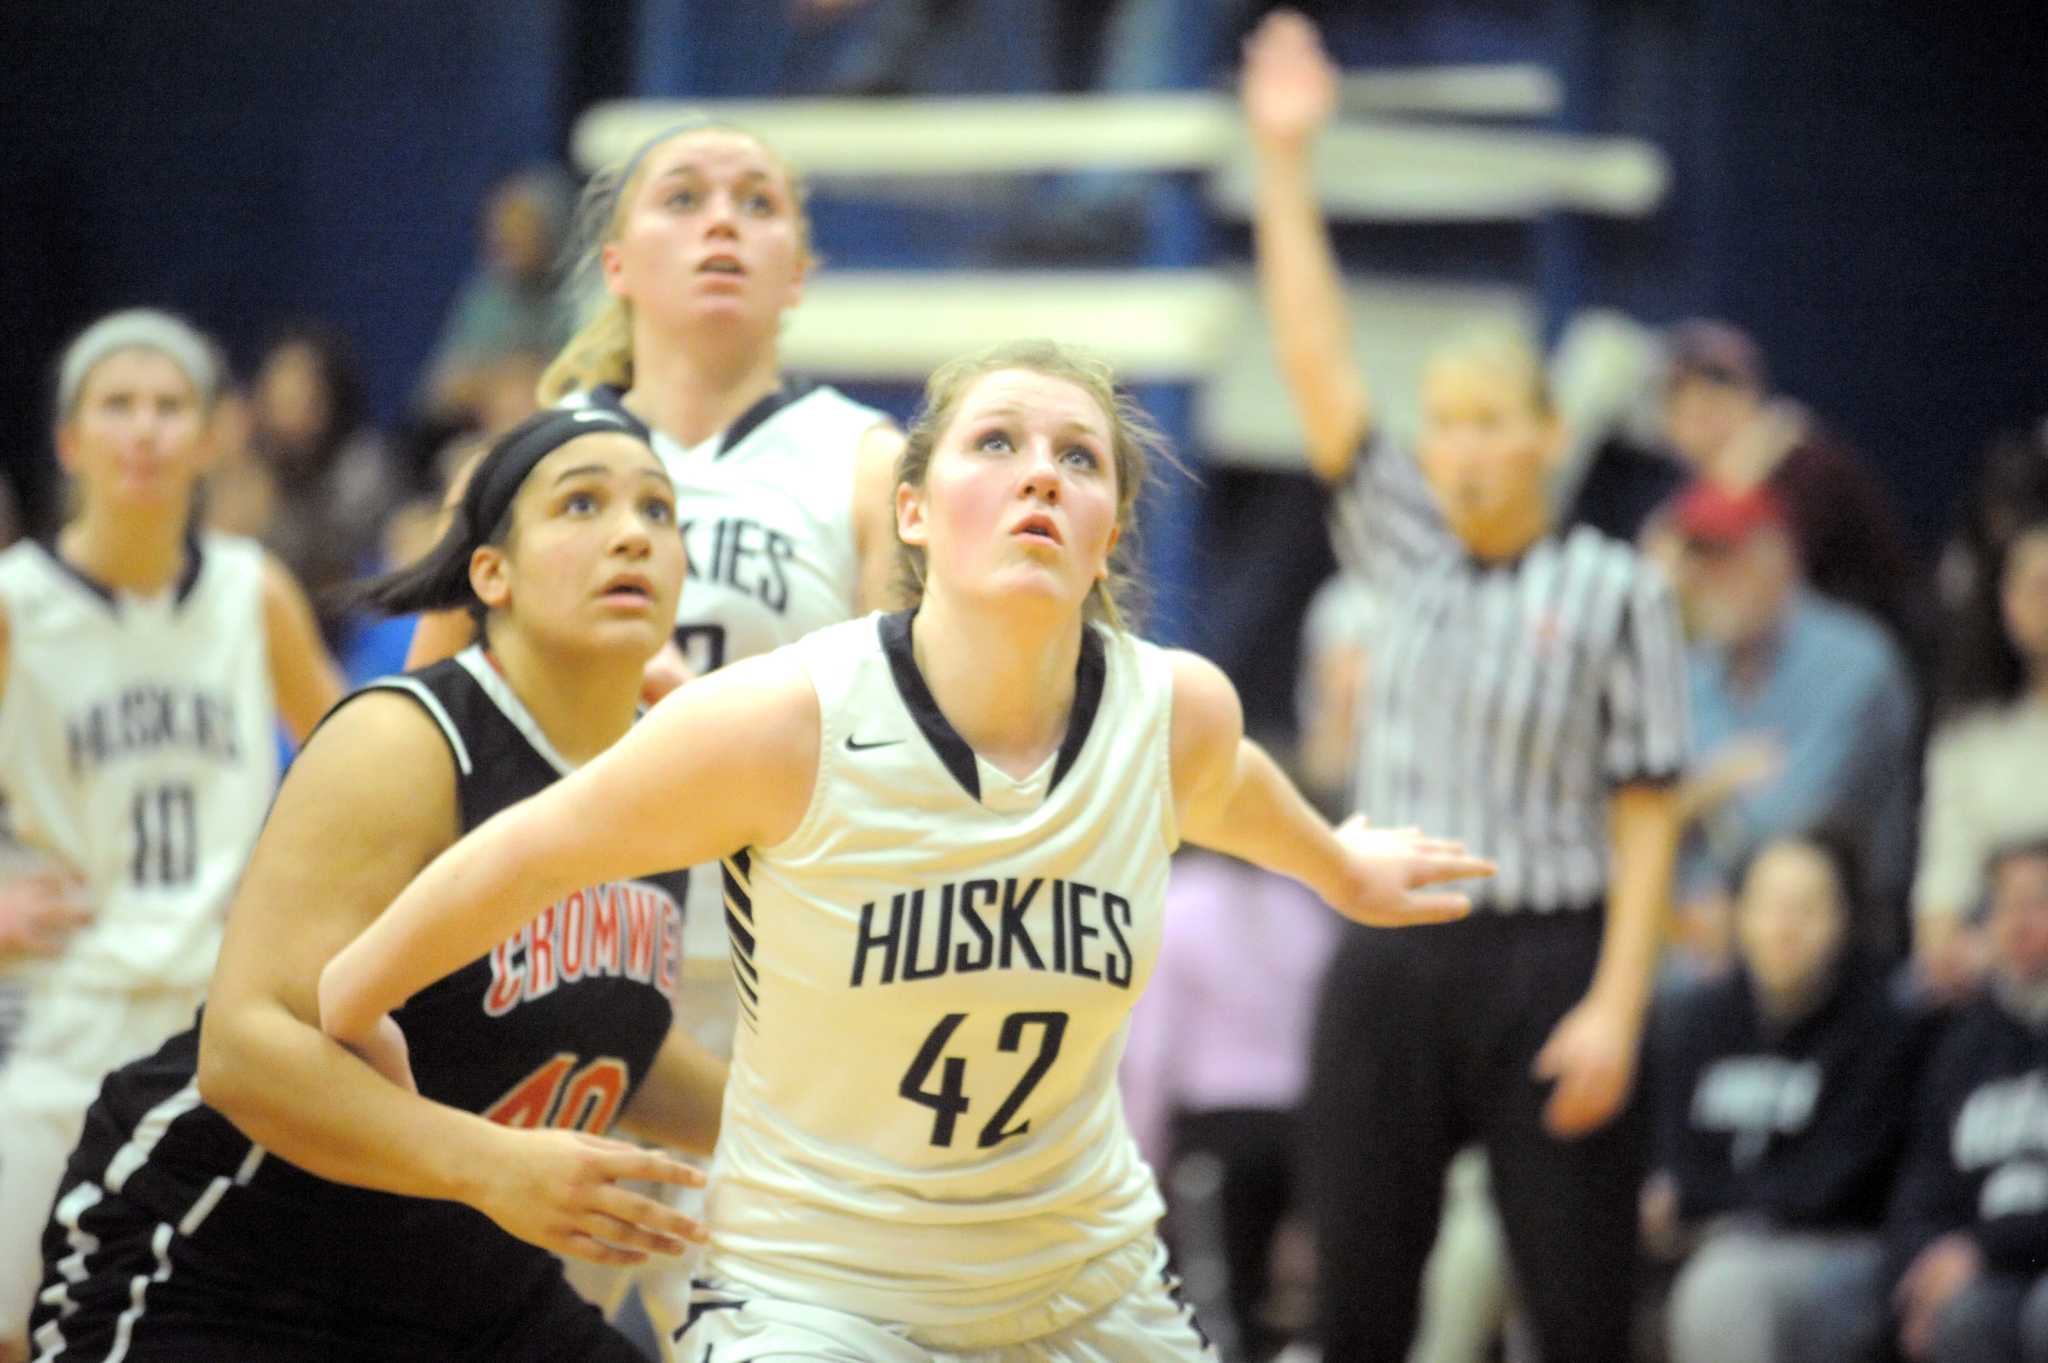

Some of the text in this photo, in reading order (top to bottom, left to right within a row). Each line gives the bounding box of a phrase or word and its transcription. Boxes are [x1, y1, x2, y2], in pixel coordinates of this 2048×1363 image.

[130, 784, 197, 887] 10
[849, 877, 1133, 989] HUSKIES
[899, 1011, 1070, 1149] 42
